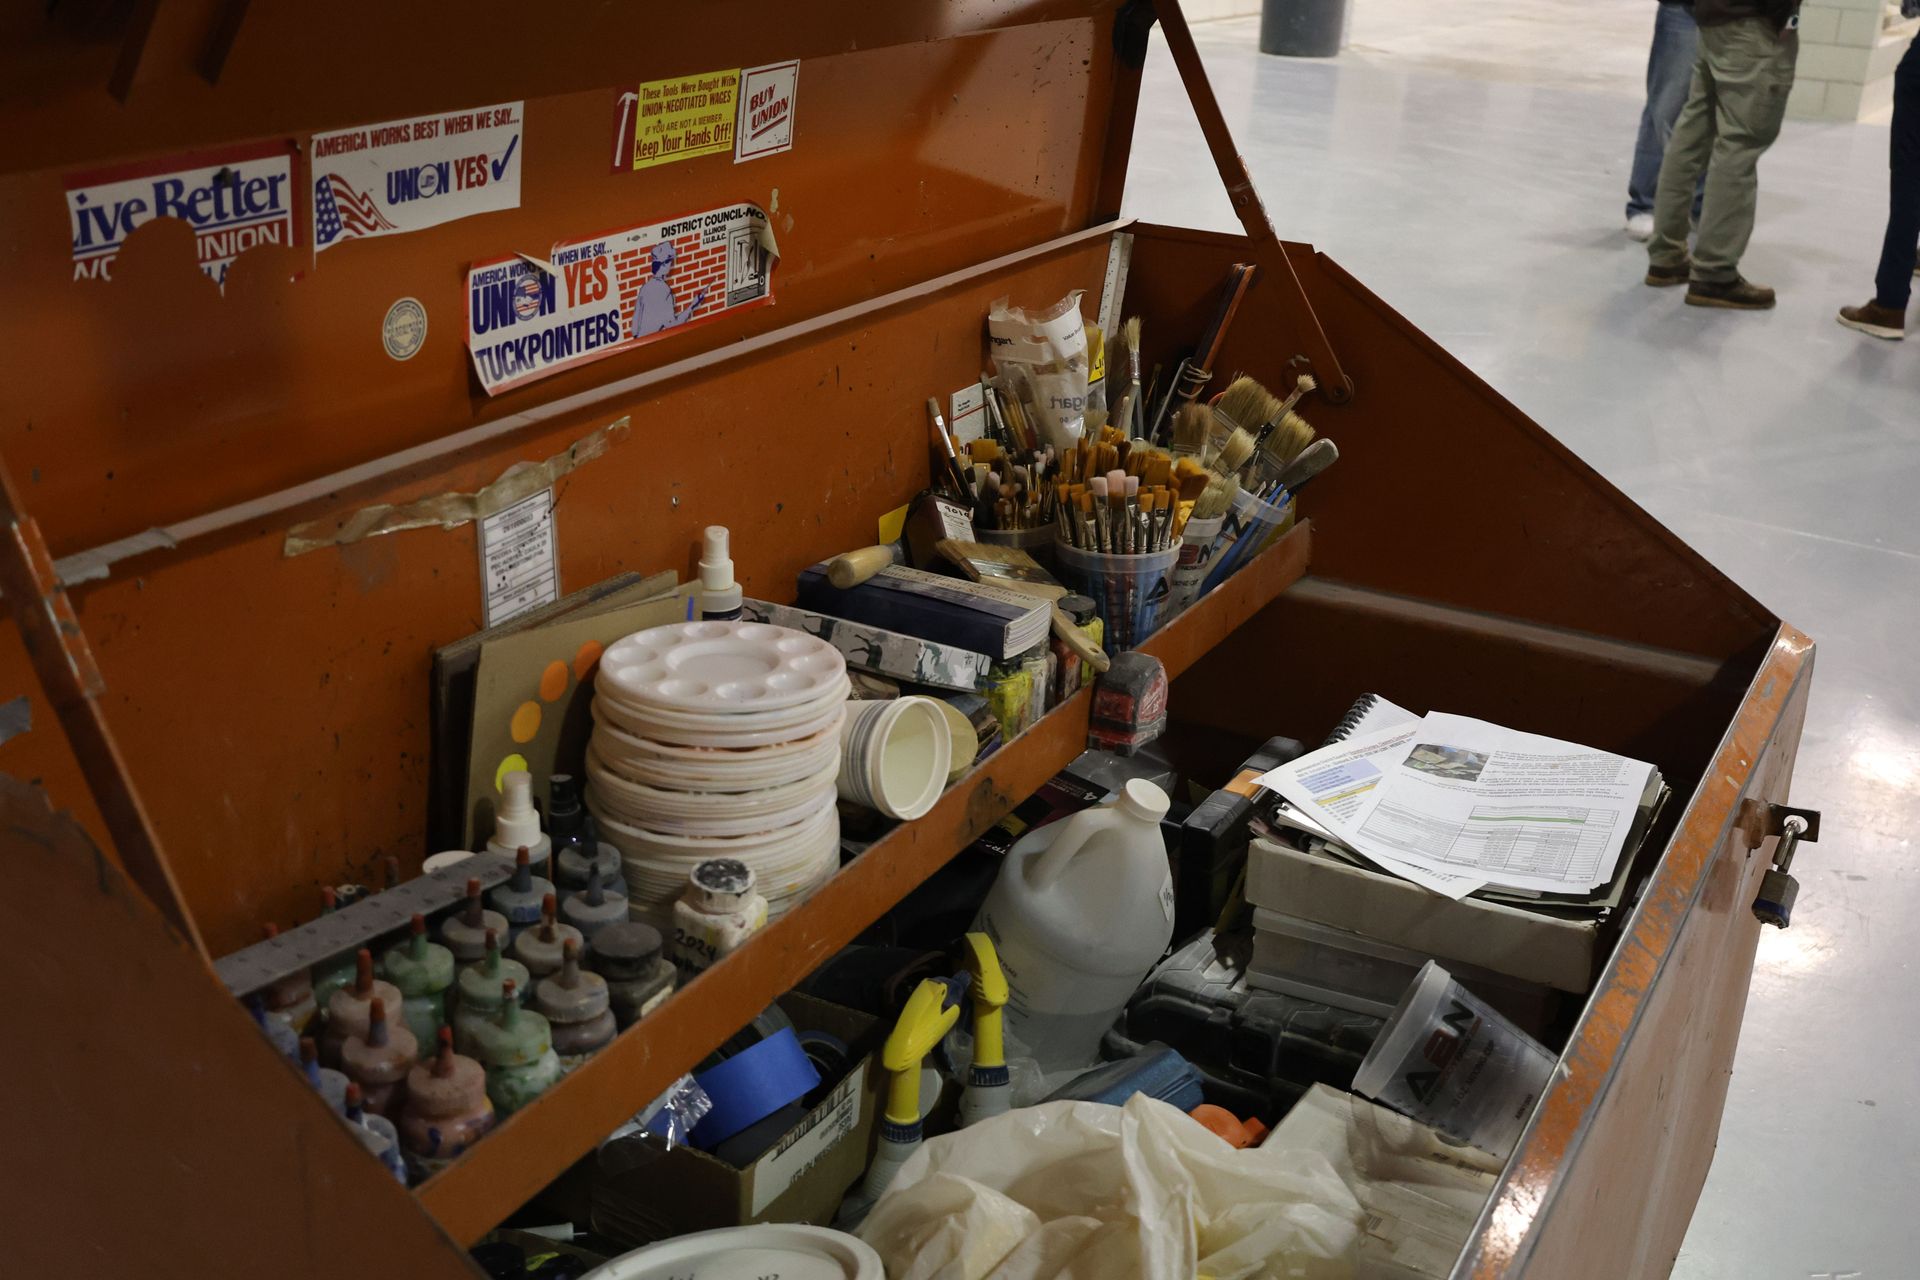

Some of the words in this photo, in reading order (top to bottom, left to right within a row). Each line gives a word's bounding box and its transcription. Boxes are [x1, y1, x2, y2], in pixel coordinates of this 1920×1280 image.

[642, 87, 661, 100] These
[663, 84, 679, 97] Tools
[681, 81, 697, 94] Were
[698, 78, 719, 92] Bought
[721, 75, 737, 88] With
[709, 90, 732, 106] WAGES
[750, 84, 776, 113] BUY
[645, 126, 651, 135] IF
[652, 121, 665, 134] YOU
[666, 120, 678, 131] ARE
[679, 118, 692, 129] NOT
[692, 117, 697, 126] A
[751, 96, 789, 130] UNION
[315, 131, 368, 158] AMERICA
[371, 124, 410, 149] WORKS
[413, 119, 440, 140] BEST
[444, 113, 474, 136] WHEN
[476, 111, 492, 130] WE
[636, 138, 659, 160] Keep
[661, 134, 682, 152] Your
[684, 128, 711, 147] Hands
[713, 122, 732, 141] Off!
[386, 161, 450, 205] UNION
[454, 154, 488, 191] YES
[74, 193, 147, 247] ive
[153, 170, 287, 224] Better
[661, 217, 704, 238] DISTRICT
[703, 225, 727, 237] ILLINOIS
[558, 250, 579, 266] WHEN
[580, 246, 592, 259] WE
[472, 267, 508, 288] AMERICA
[472, 270, 556, 335] UNION
[563, 255, 609, 309] YES
[474, 309, 620, 384] TUCKPOINTERS
[673, 928, 717, 961] 2024
